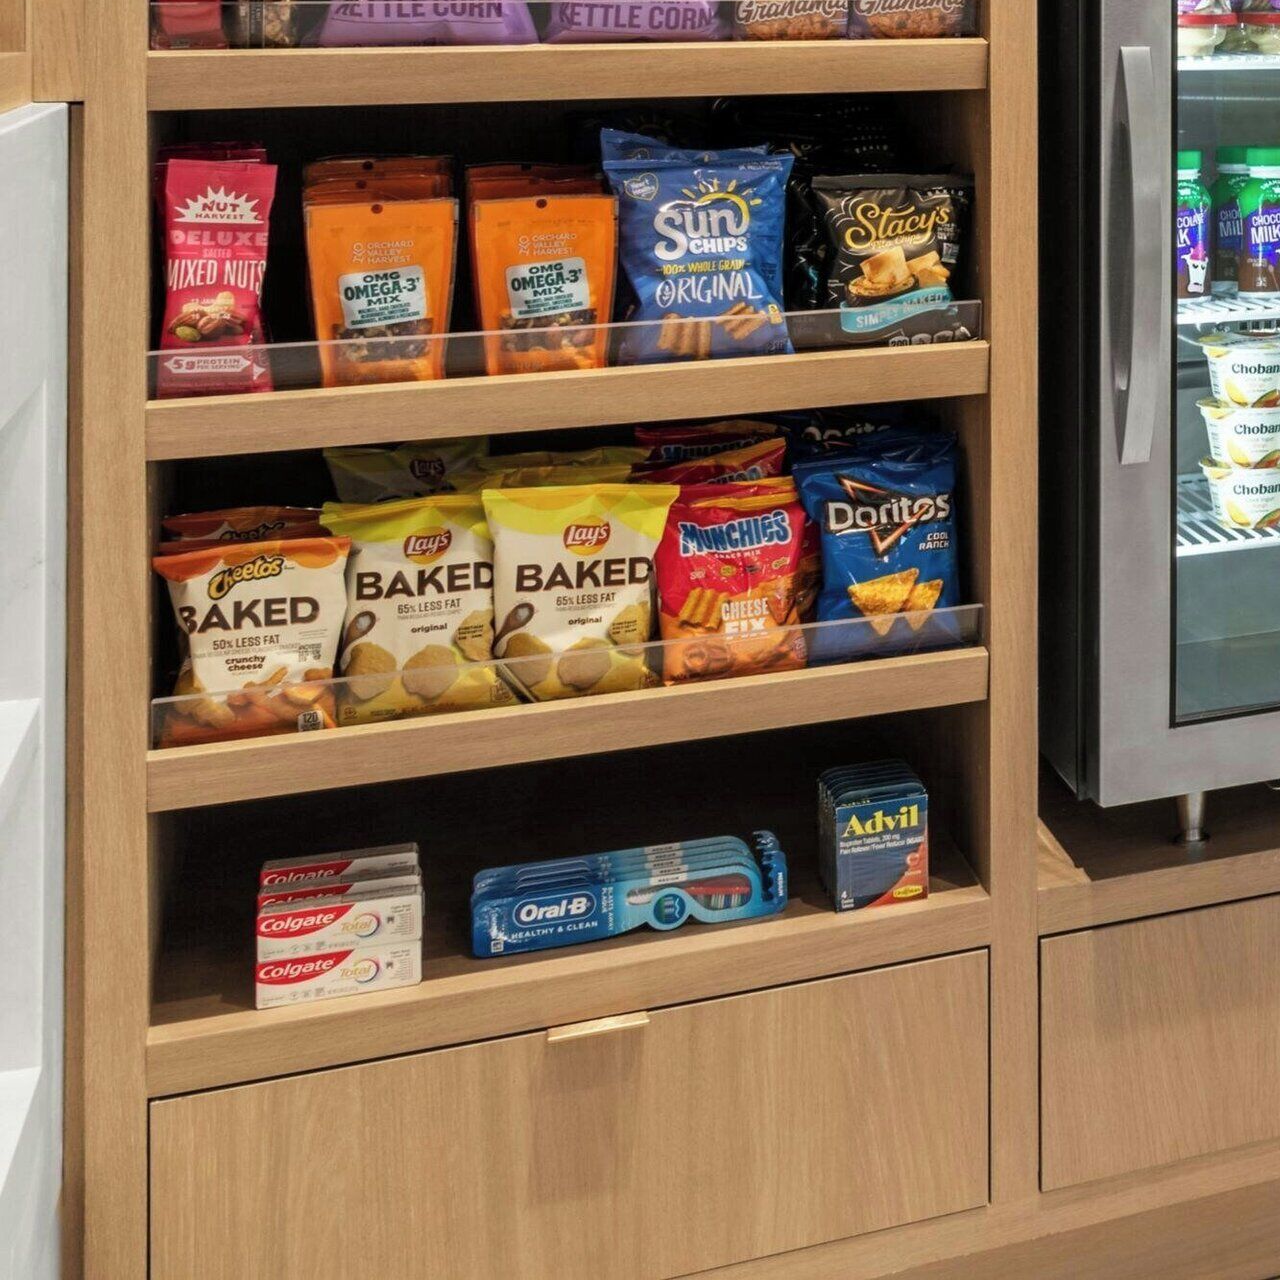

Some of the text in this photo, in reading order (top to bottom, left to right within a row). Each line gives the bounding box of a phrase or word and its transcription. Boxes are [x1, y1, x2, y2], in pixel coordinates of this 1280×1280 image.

[559, 2, 713, 30] KETTLE CORN
[201, 201, 240, 212] NUT
[654, 193, 750, 260] Sun
[845, 203, 950, 249] Stacy's
[171, 230, 268, 246] DELUXE
[688, 237, 747, 254] CHIPS
[168, 259, 266, 294] MIXED NUTS
[363, 272, 400, 283] OMG
[529, 263, 563, 274] OMG
[533, 286, 564, 297] MIX
[655, 273, 763, 307] ORIGINAL
[367, 295, 400, 306] MIX
[197, 357, 241, 365] PROTEIN
[827, 493, 950, 531] Doritos
[679, 510, 790, 556] MUNCHIES
[927, 532, 949, 541] COOL
[918, 541, 949, 551] RANCH
[208, 554, 285, 600] Cheetos
[356, 563, 494, 601] BAKED
[516, 557, 651, 592] BAKED
[419, 599, 461, 612] LESS FAT
[722, 598, 768, 621] CHEESE
[178, 596, 320, 635] BAKED
[568, 616, 602, 625] original
[411, 623, 447, 635] original
[213, 635, 280, 650] 50% LESS FAT
[225, 655, 265, 666] crunchy
[841, 804, 919, 838] Advil
[519, 898, 590, 921] Oral-B
[260, 912, 335, 932] Colgate
[511, 927, 555, 939] HEALTHY
[566, 921, 598, 931] CLEAN
[259, 958, 335, 979] Colgate
